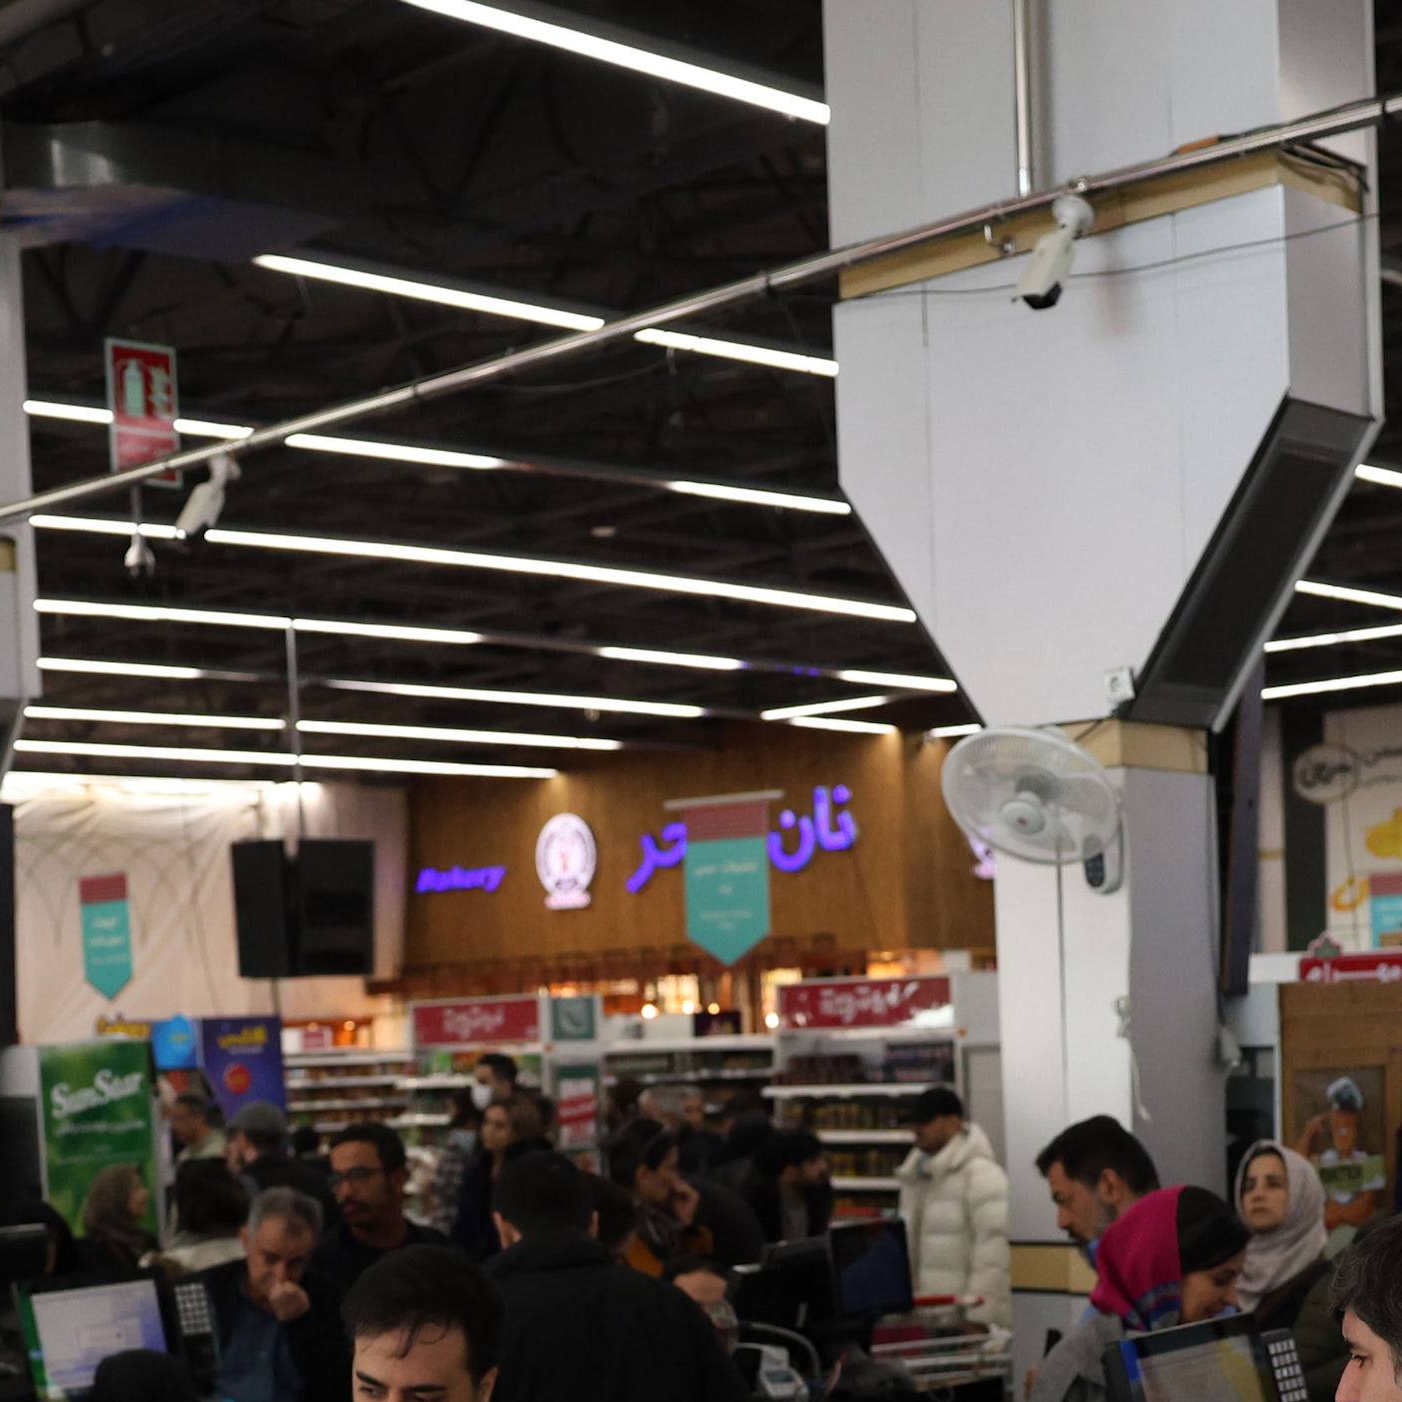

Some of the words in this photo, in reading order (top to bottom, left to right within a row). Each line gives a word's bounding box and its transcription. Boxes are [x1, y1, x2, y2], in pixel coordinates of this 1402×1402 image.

[767, 784, 857, 873] نان
[416, 864, 507, 894] Bakery
[51, 1069, 146, 1119] SunStar
